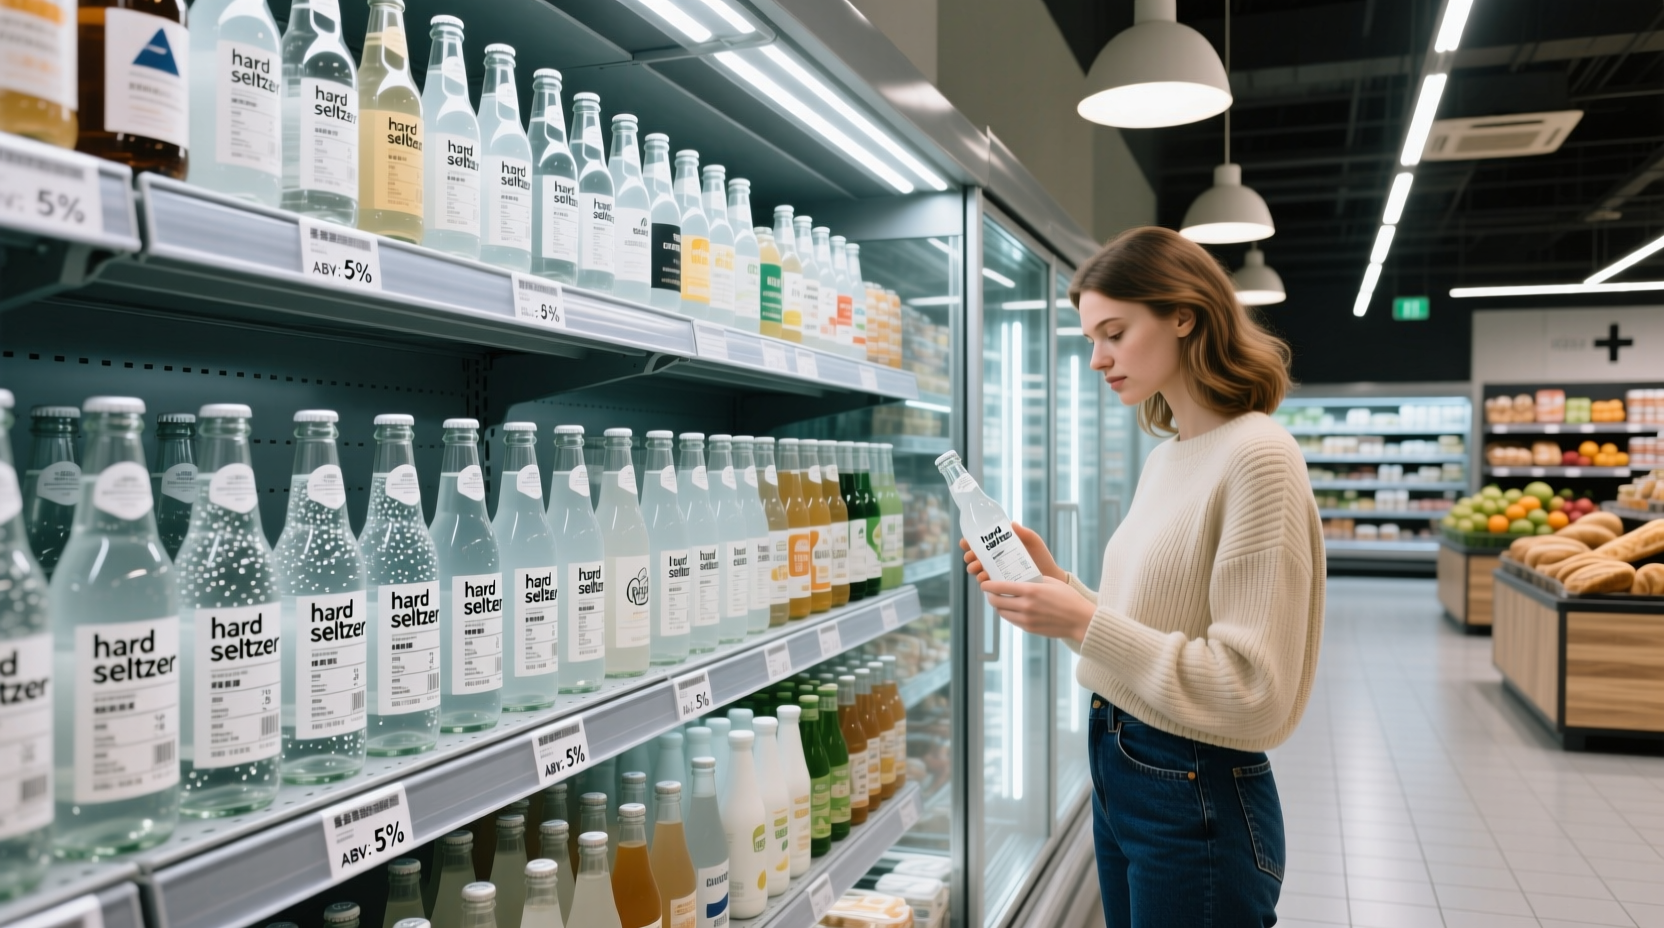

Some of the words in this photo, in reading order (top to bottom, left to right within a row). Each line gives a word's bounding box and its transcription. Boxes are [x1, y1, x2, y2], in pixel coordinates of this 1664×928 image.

[231, 48, 270, 74] hard
[230, 67, 280, 96] seltzer
[315, 85, 348, 107] hard
[388, 116, 417, 136] hard
[37, 189, 85, 224] 5%
[313, 261, 341, 278] ABV:
[344, 258, 373, 284] 5%
[464, 579, 496, 599] hard
[525, 572, 552, 590] hard
[311, 598, 354, 623] hard
[391, 588, 430, 610] hard
[211, 612, 262, 640] hard
[390, 606, 440, 629] seltzer
[310, 619, 366, 643] seltzer
[93, 628, 155, 660] hard
[210, 635, 280, 662] seltzer
[92, 653, 177, 684] seltzer
[565, 744, 586, 767] 5%
[340, 842, 373, 869] ABV:
[374, 820, 405, 853] 5%
